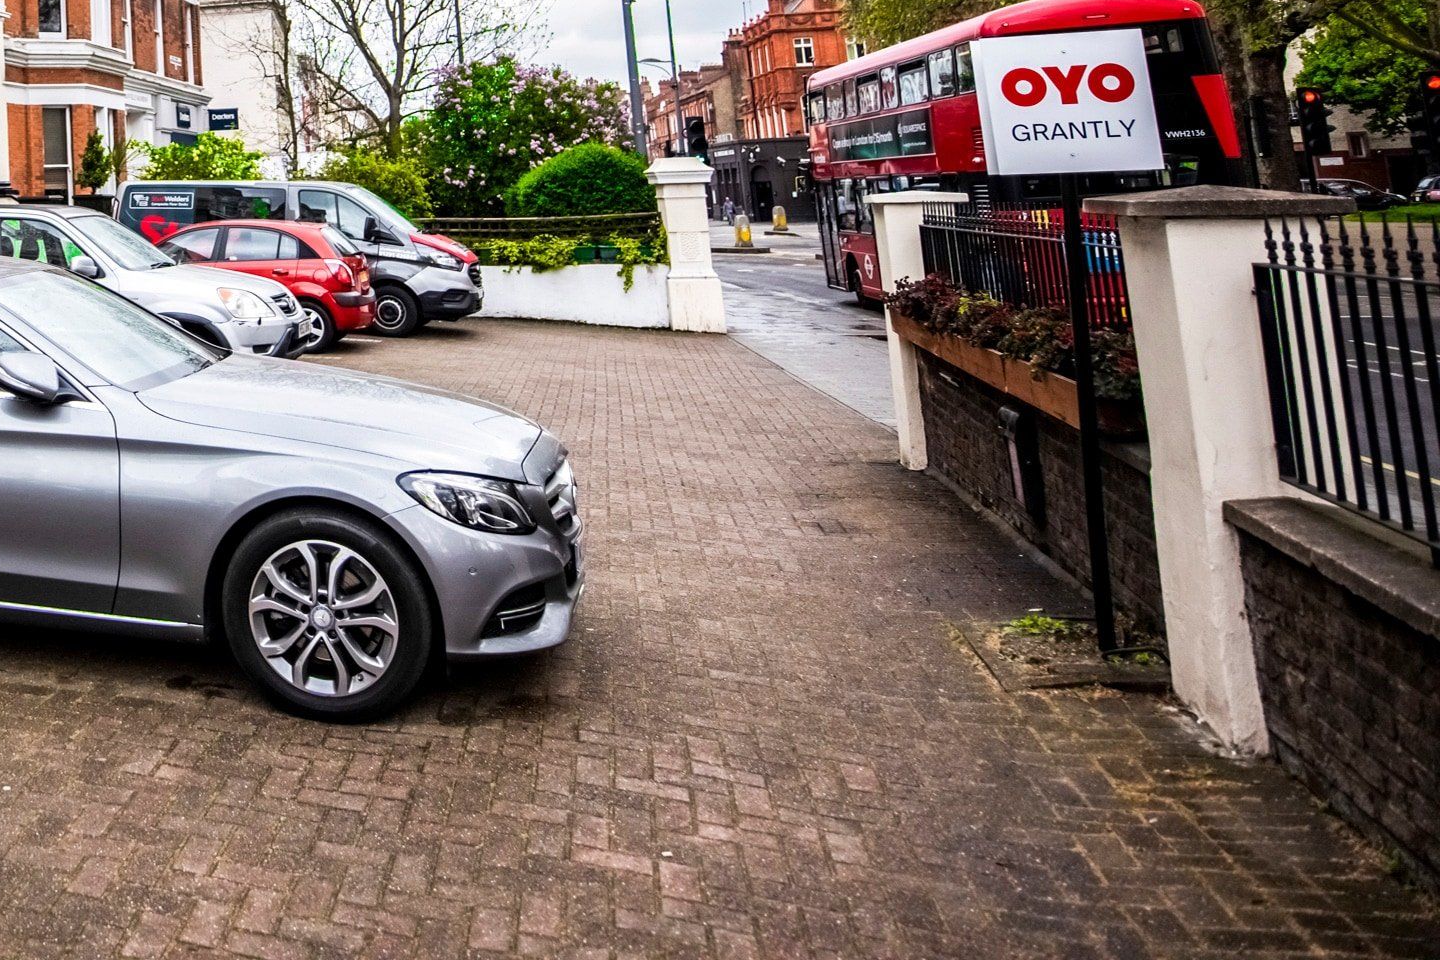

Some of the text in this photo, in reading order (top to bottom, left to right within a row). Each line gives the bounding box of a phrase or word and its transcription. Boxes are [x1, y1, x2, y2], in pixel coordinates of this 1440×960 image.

[1000, 62, 1136, 107] OYO
[1011, 118, 1136, 142] GRANTLY
[1164, 129, 1206, 138] VWH2136
